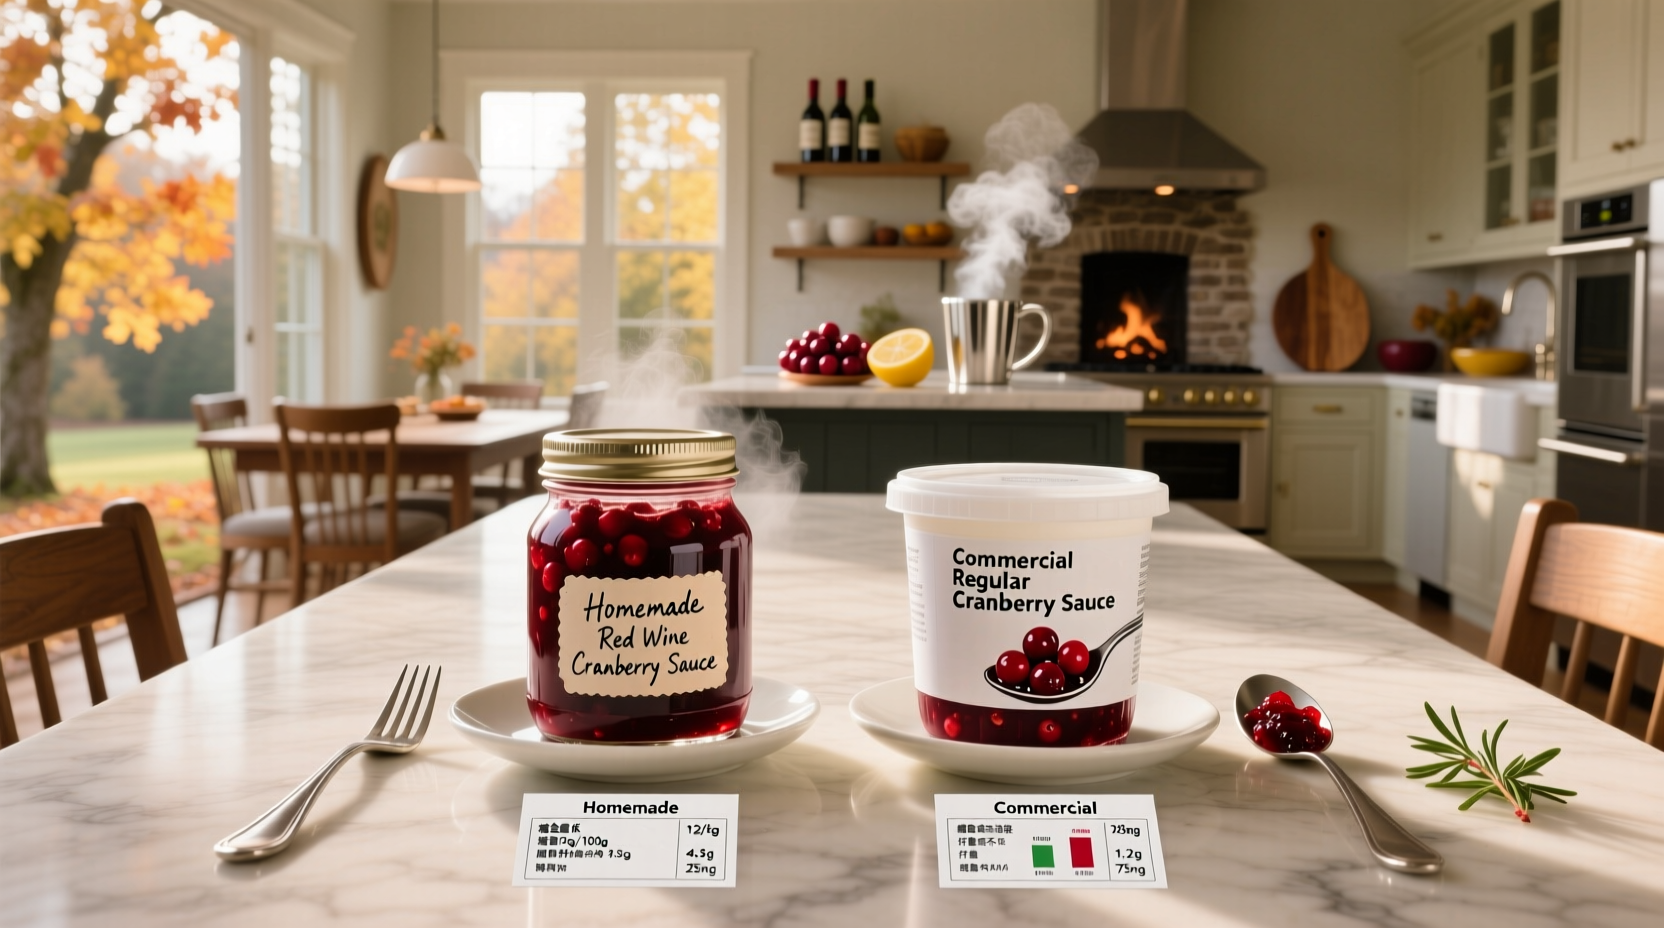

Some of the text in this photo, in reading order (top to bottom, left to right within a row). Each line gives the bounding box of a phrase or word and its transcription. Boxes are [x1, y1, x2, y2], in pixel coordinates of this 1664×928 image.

[953, 547, 1073, 569] Commercial
[953, 569, 1031, 593] Regular
[583, 589, 704, 622] Homemade
[953, 591, 1116, 617] Cranberry Sauce
[598, 624, 690, 651] Red Wine
[571, 650, 718, 686] Cranberry Sauce
[583, 800, 679, 815] Homemade
[994, 800, 1098, 815] Commercial
